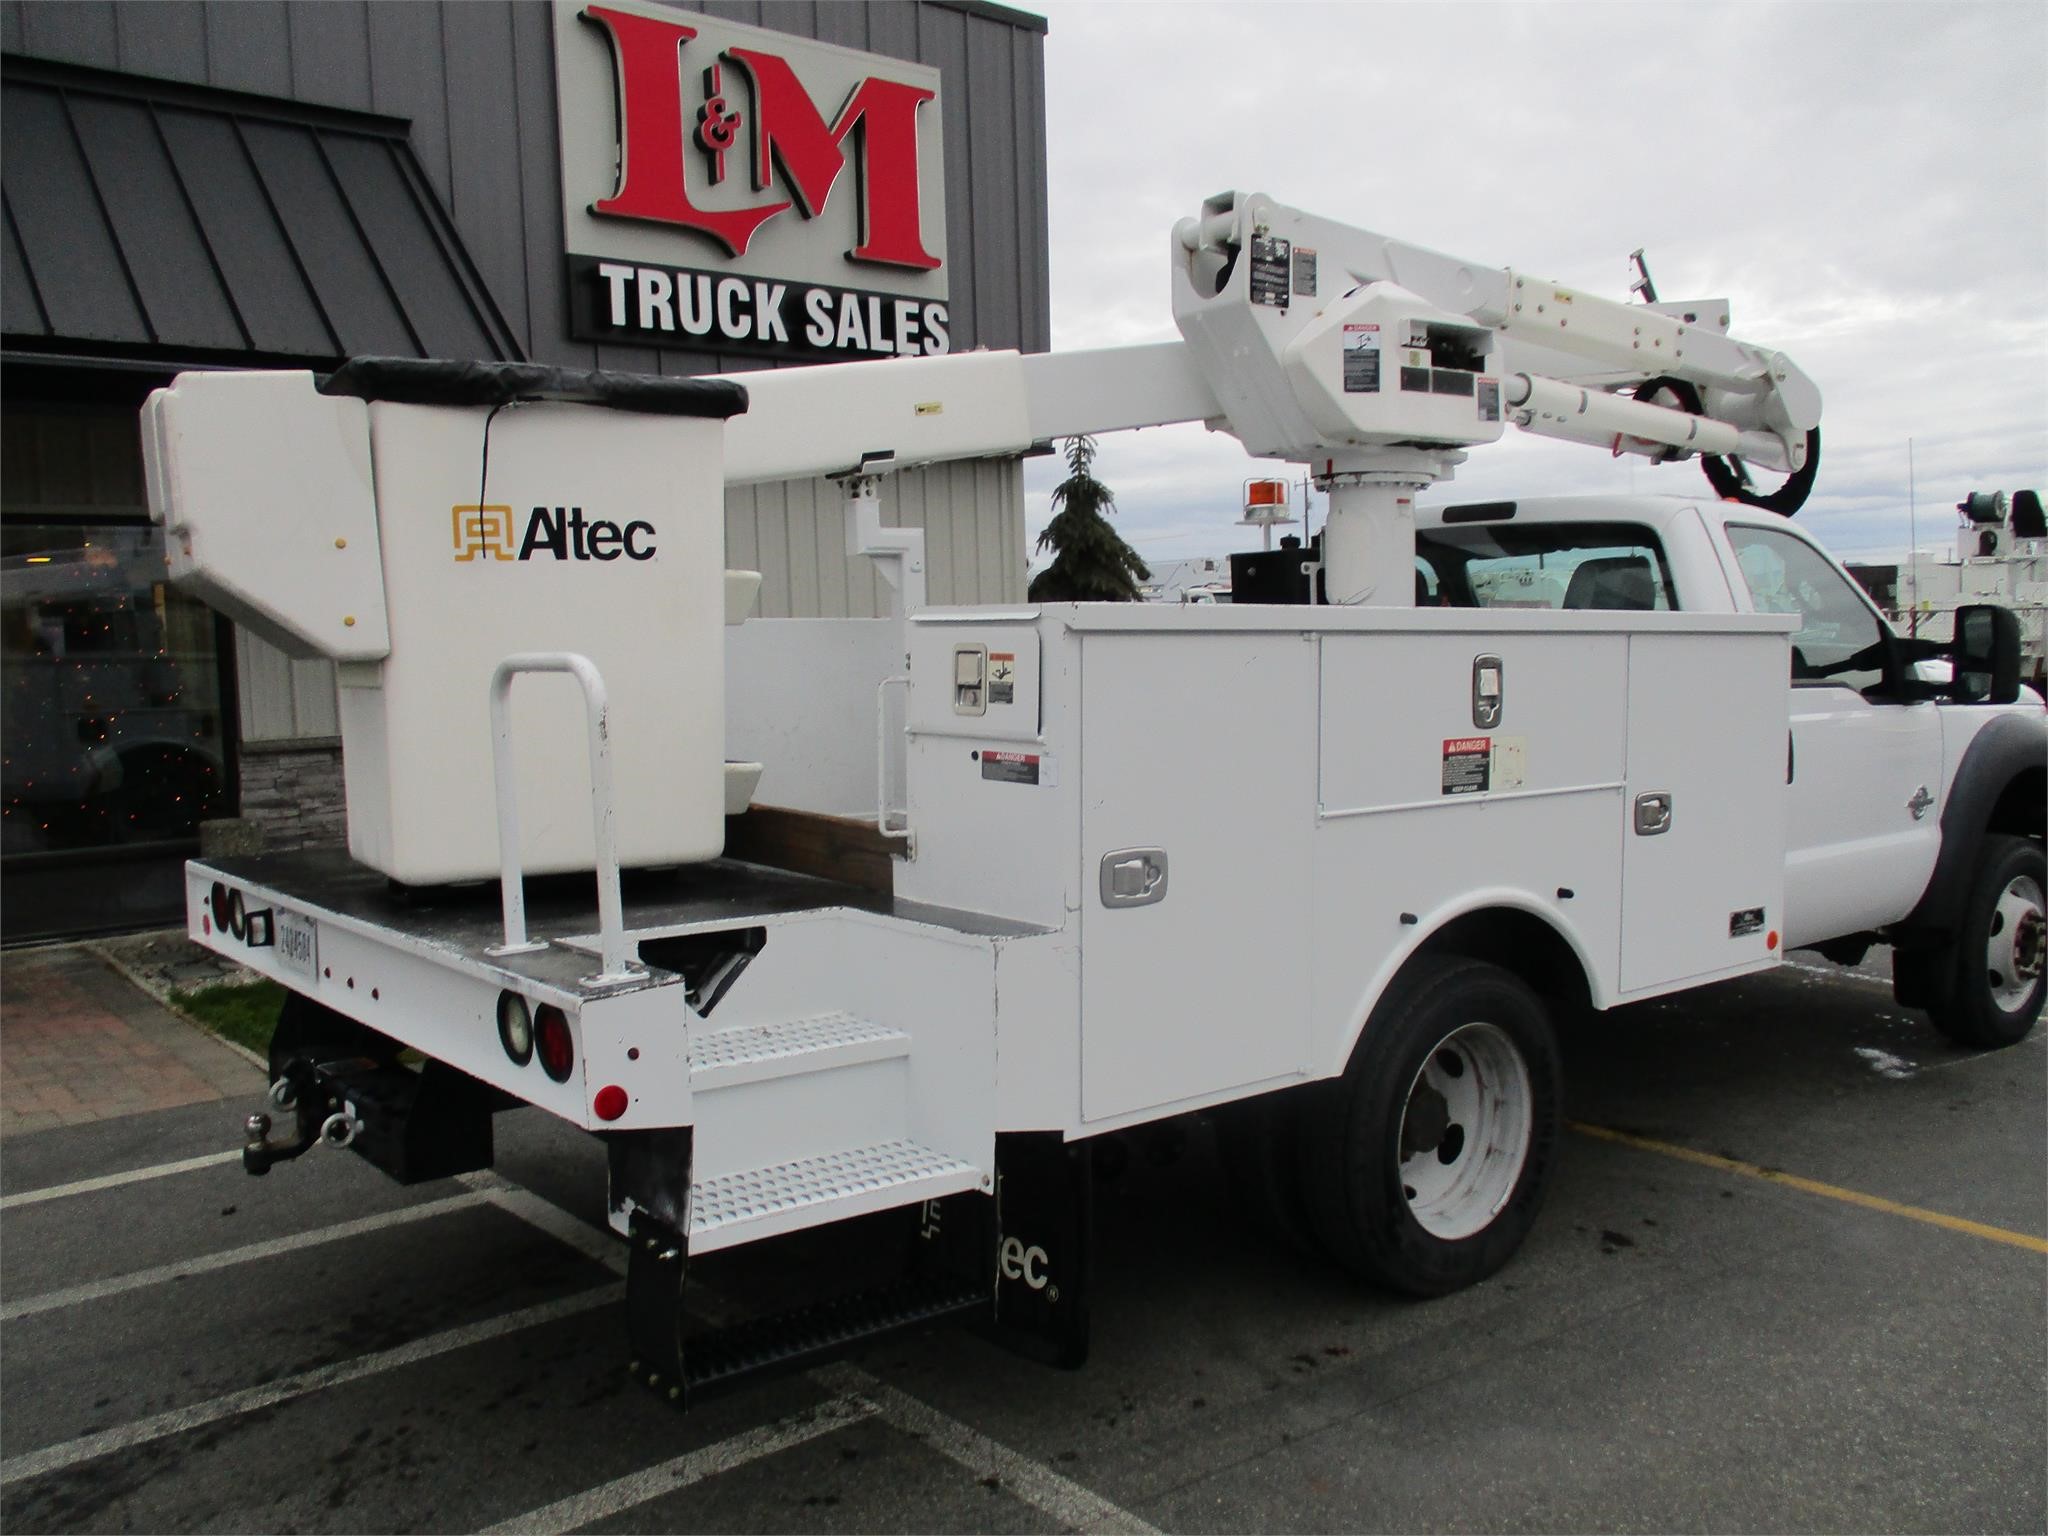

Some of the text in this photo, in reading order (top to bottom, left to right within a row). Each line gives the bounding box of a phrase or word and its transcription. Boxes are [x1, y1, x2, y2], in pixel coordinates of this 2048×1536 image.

[599, 262, 950, 356] TRUCK SALES
[518, 506, 657, 561] Altec
[1456, 740, 1486, 752] DANGER
[1000, 1236, 1049, 1290] ec
